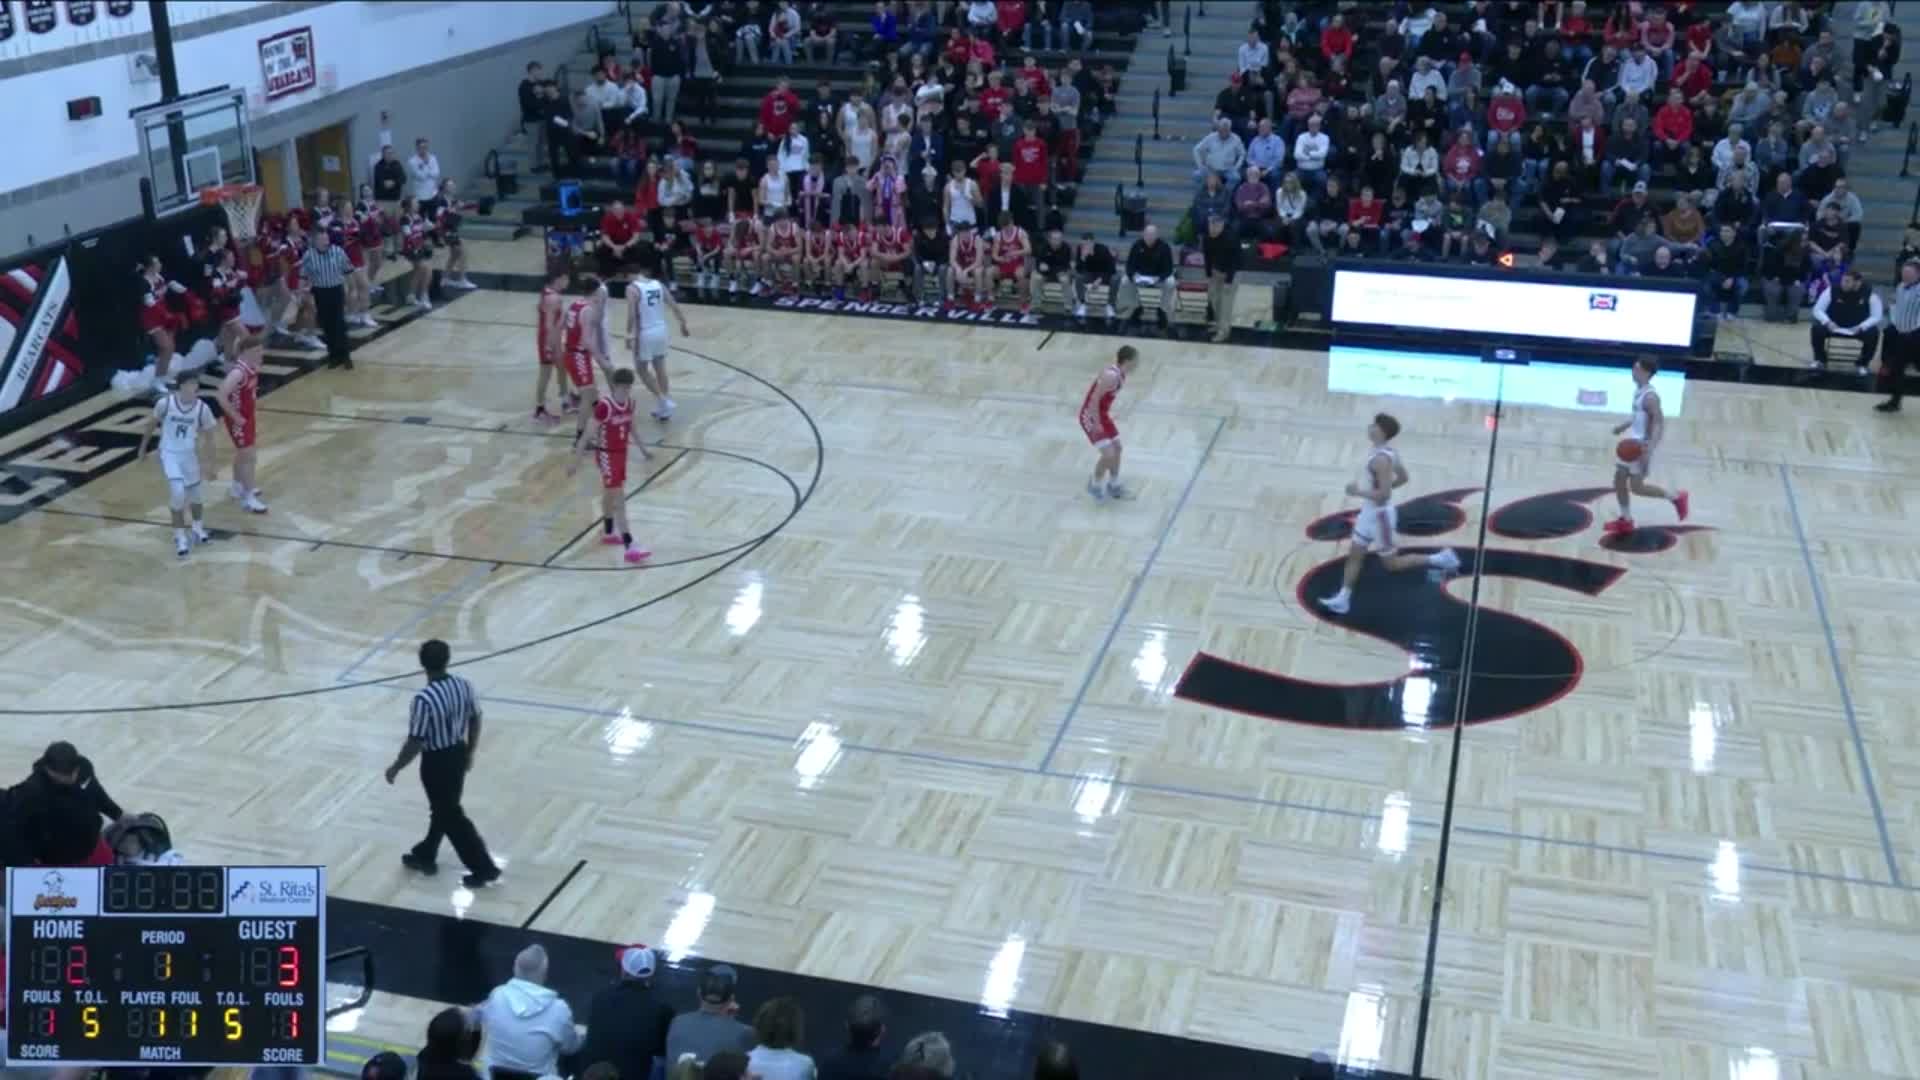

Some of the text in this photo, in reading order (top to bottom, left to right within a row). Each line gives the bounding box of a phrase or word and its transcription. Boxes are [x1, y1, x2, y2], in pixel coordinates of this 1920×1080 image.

[774, 296, 1045, 325] SPENCERVILLE
[16, 302, 59, 382] BEARCATS
[175, 423, 189, 440] 14
